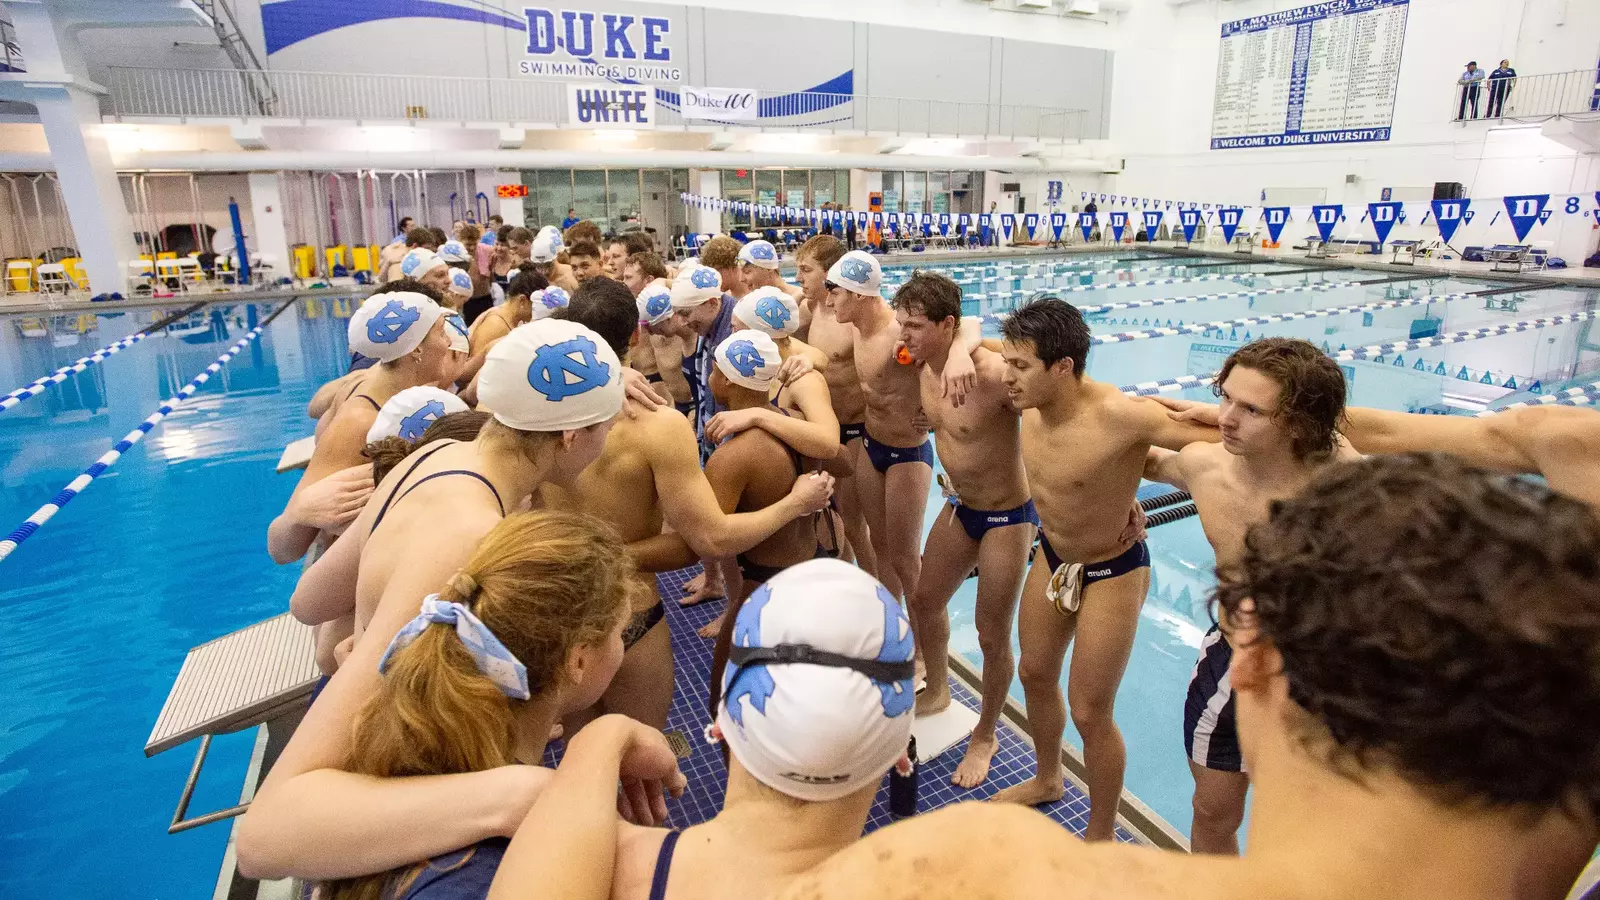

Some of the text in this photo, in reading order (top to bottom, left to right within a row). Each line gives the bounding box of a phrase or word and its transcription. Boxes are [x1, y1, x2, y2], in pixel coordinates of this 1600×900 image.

[1250, 7, 1304, 26] MATTHEW
[525, 9, 670, 61] DUKE
[520, 62, 680, 80] SWIMMING & DIVING
[576, 89, 648, 123] UNITE
[1221, 130, 1377, 148] WELCOME TO DUKE UNIVERSITY
[1439, 203, 1461, 220] D
[1513, 199, 1538, 217] D
[1564, 196, 1580, 214] 8
[1041, 215, 1047, 226] 6
[1207, 211, 1214, 224] 7
[1268, 210, 1284, 225] D
[1318, 209, 1336, 224] D
[1375, 206, 1394, 222] D
[1087, 568, 1112, 577] arena
